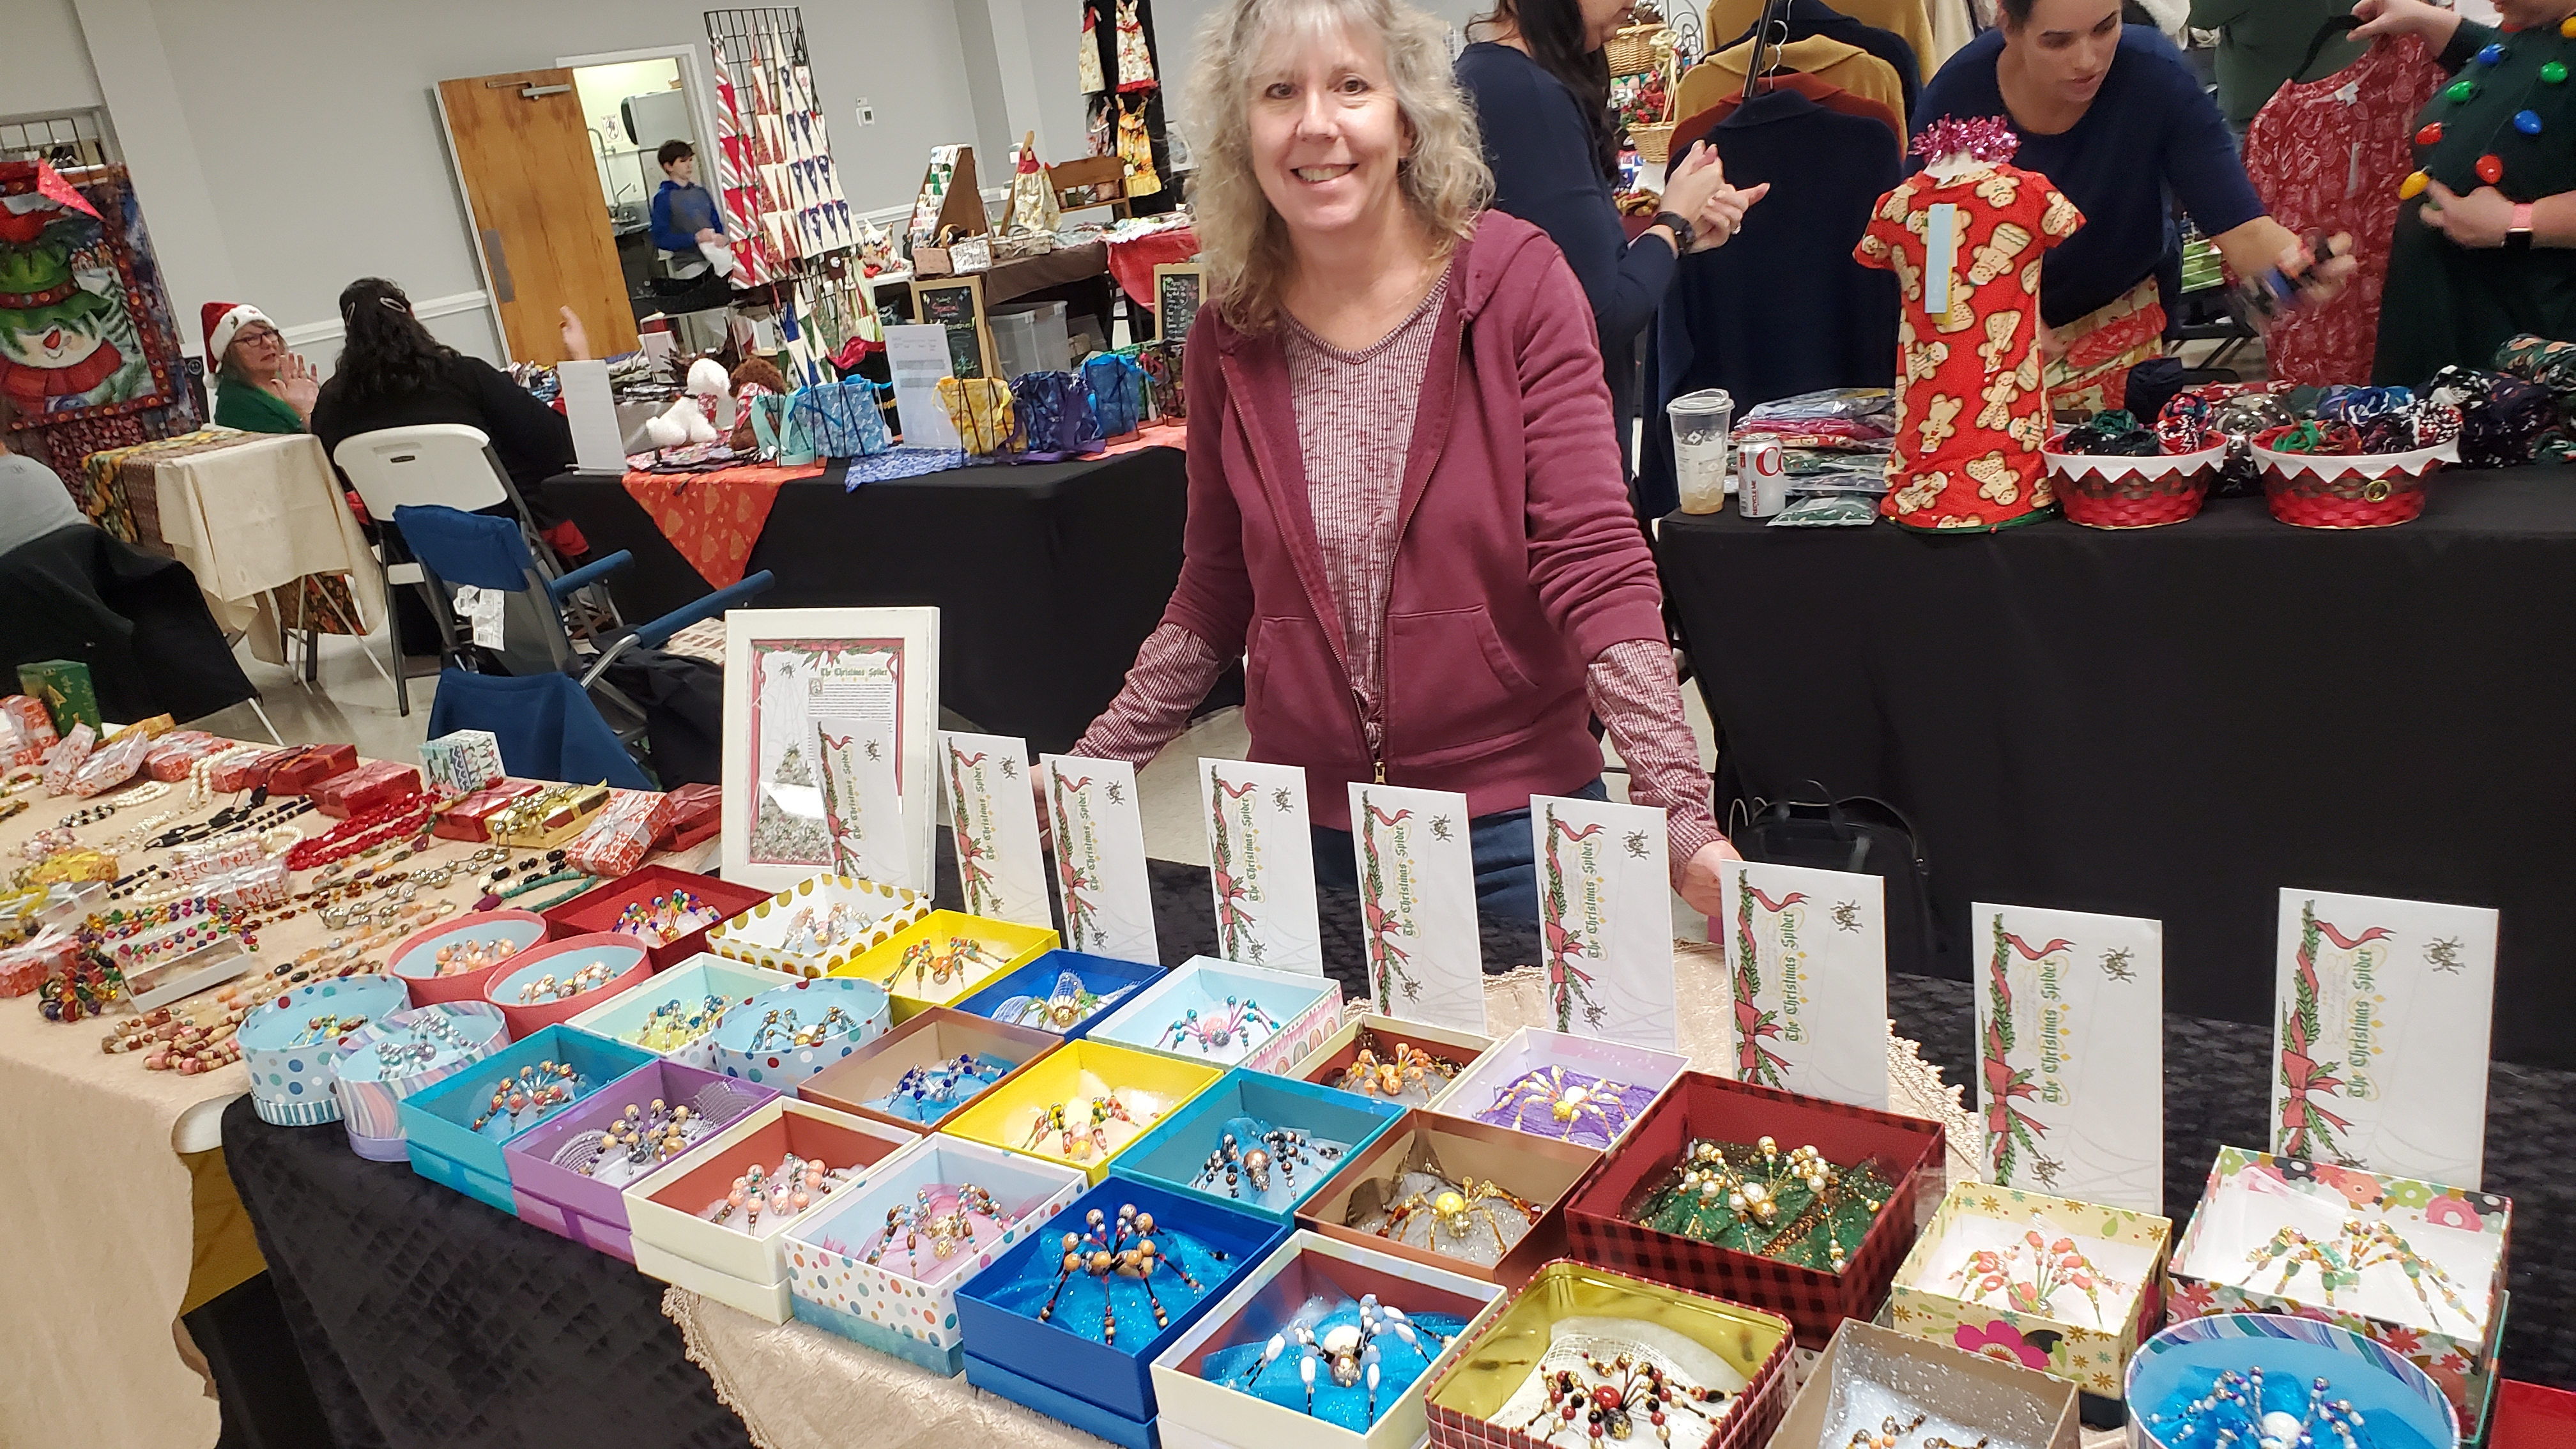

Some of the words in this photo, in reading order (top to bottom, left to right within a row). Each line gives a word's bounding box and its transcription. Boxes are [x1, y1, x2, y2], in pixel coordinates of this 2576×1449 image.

[1751, 480, 1756, 489] ME
[834, 668, 865, 677] Christmas
[868, 668, 887, 677] Spider
[841, 749, 852, 775] Spider
[973, 766, 985, 793] Spider
[846, 780, 858, 821] Christmas
[1078, 791, 1090, 820] Spider
[1240, 797, 1253, 827] Spider
[853, 825, 861, 839] The
[979, 799, 992, 841] Christmas
[986, 845, 995, 860] The
[1084, 825, 1096, 871] Christmas
[1245, 833, 1258, 880] Christmas
[1394, 825, 1408, 859] Spider
[1581, 841, 1597, 875] Spider
[1089, 875, 1100, 891] The
[1249, 884, 1261, 901] The
[1399, 863, 1413, 914] Christmas
[1584, 881, 1599, 935] Christmas
[1402, 919, 1416, 937] The
[1780, 911, 1799, 950] Spider
[1587, 940, 1602, 959] The
[1782, 956, 1800, 1015] Christmas
[2039, 960, 2061, 1002] Spider
[2352, 948, 2375, 993] Spider
[1784, 1021, 1803, 1042] The
[2039, 1009, 2061, 1073] Christmas
[2348, 1000, 2372, 1068] Christmas
[2042, 1081, 2062, 1103] The
[2347, 1074, 2370, 1098] The
